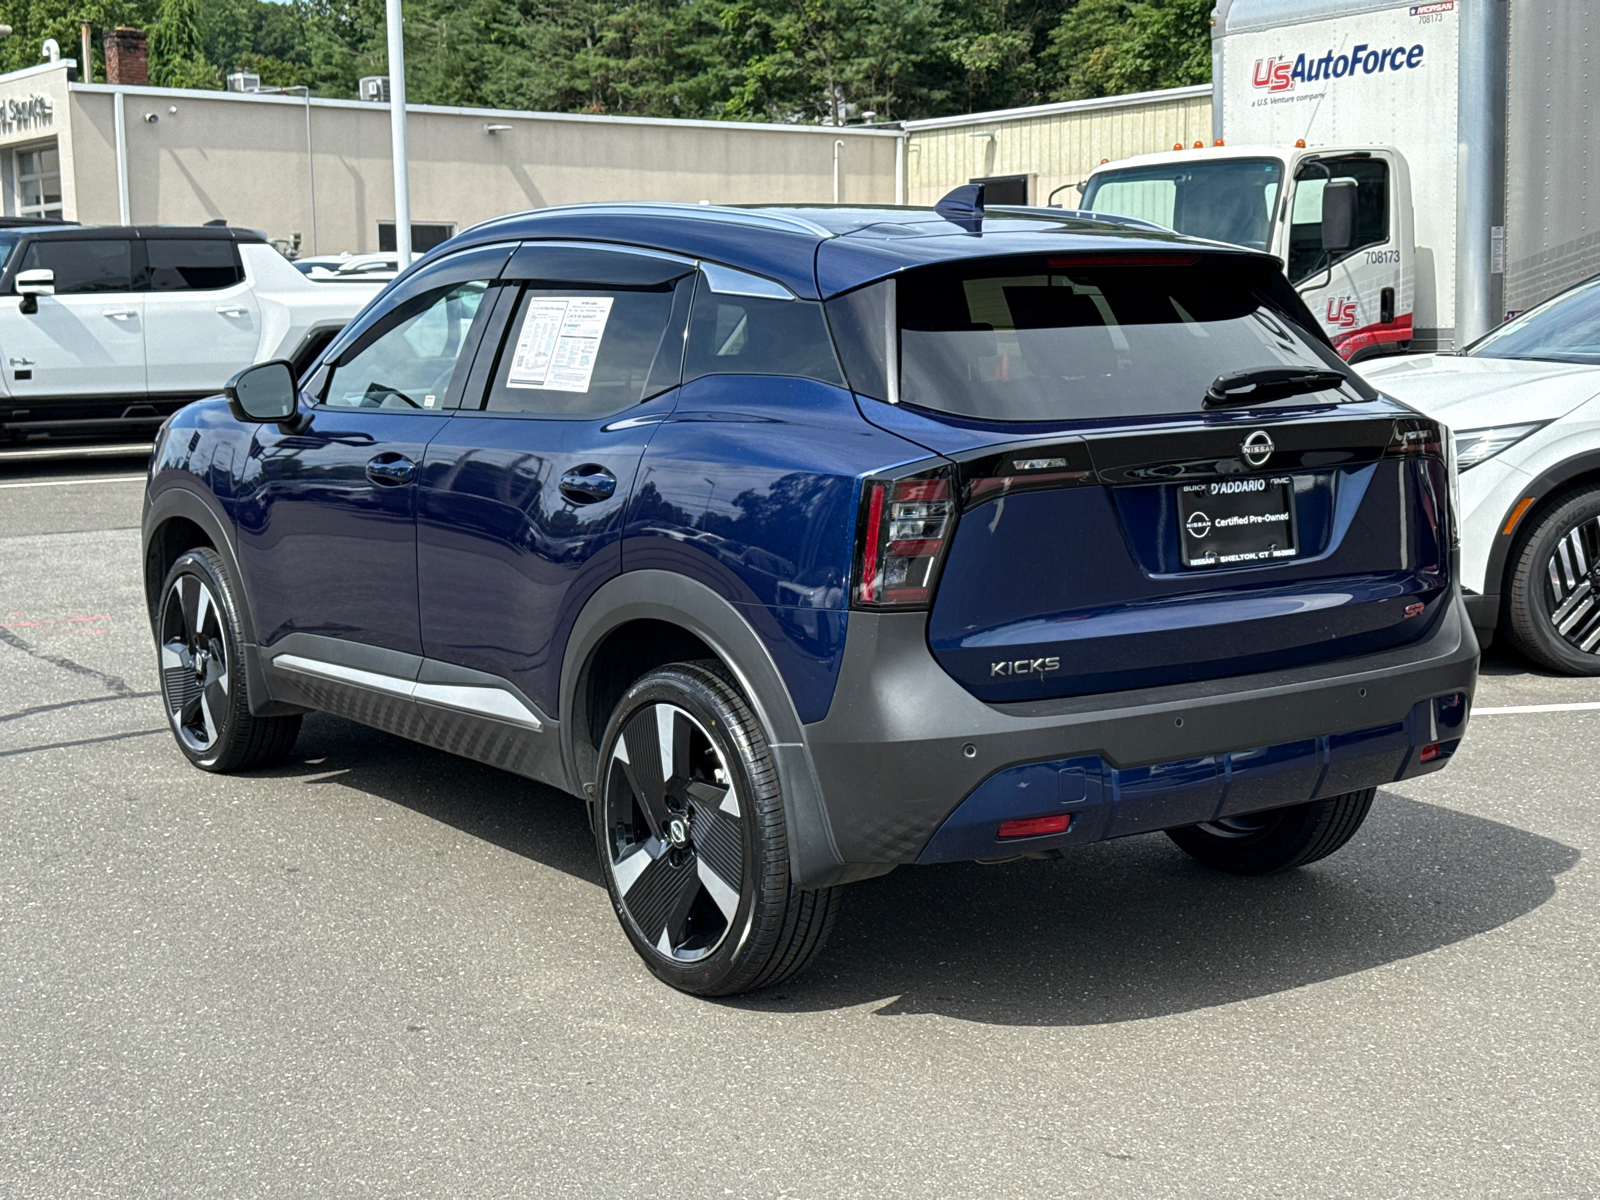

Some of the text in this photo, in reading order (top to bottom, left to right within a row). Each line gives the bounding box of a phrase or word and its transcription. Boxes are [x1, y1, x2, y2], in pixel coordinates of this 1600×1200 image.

[1416, 2, 1453, 14] MORGAN
[1418, 13, 1443, 25] 708173
[1270, 95, 1295, 105] Venture
[1296, 92, 1326, 102] company
[1364, 250, 1400, 265] 708173
[1243, 445, 1274, 454] NISSAN
[1183, 484, 1206, 492] BUICK
[1210, 479, 1265, 495] D'ADDARIO
[1215, 511, 1289, 527] Certified Pre-Owned
[1220, 552, 1258, 563] SHELTON,
[1403, 602, 1425, 618] SR
[990, 656, 1060, 677] KICKS
